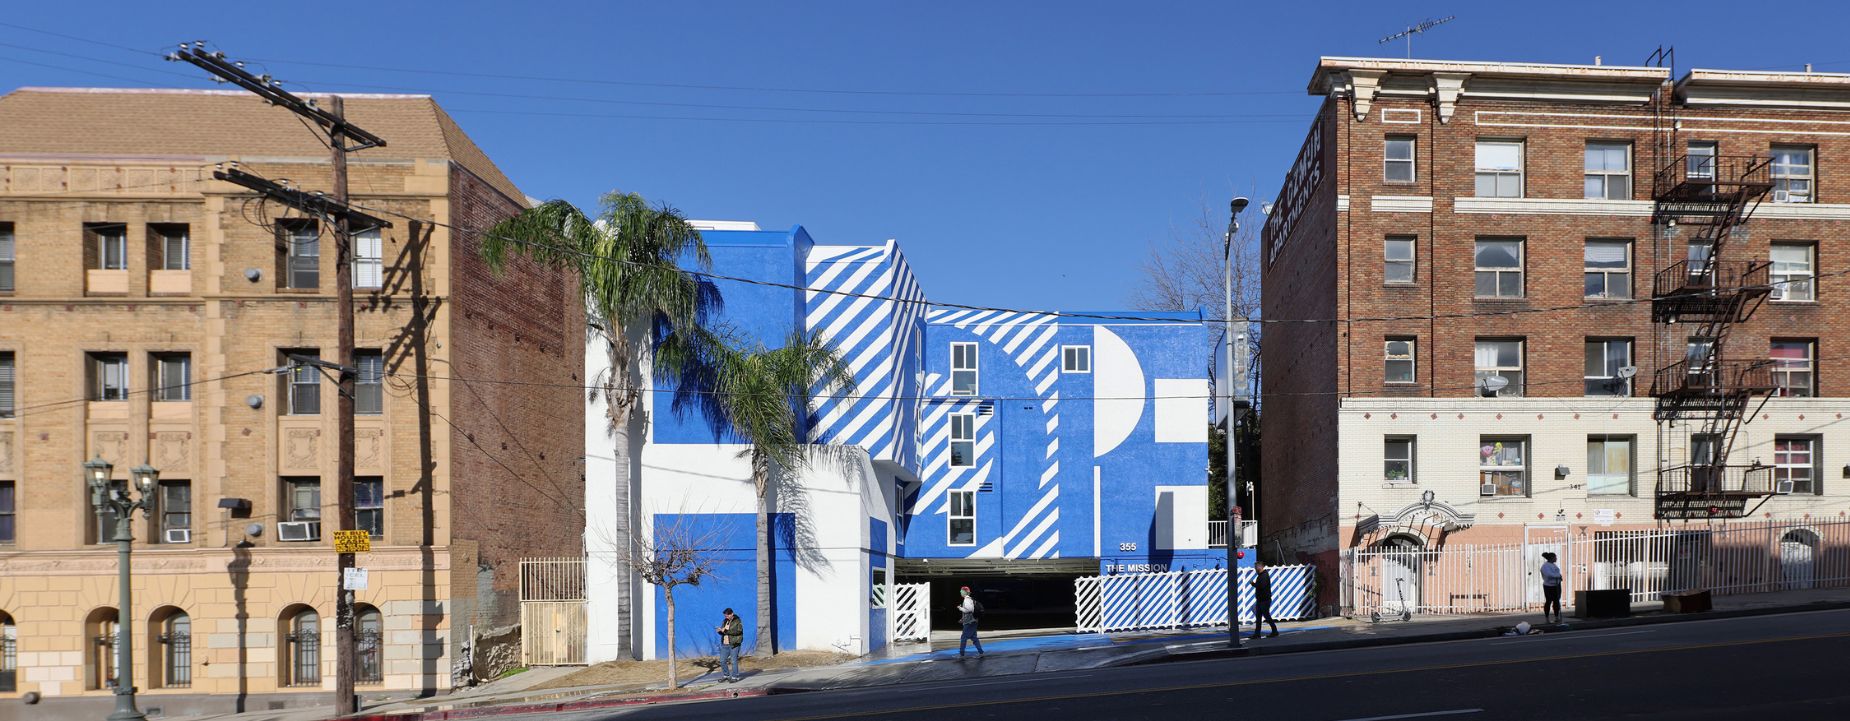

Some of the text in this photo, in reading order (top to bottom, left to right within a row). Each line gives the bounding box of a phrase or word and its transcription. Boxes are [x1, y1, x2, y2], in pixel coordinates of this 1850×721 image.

[1269, 160, 1321, 268] APARTMENTS
[1269, 199, 1284, 241] THE
[1120, 543, 1137, 551] 355
[1106, 564, 1167, 572] THE MISSION
